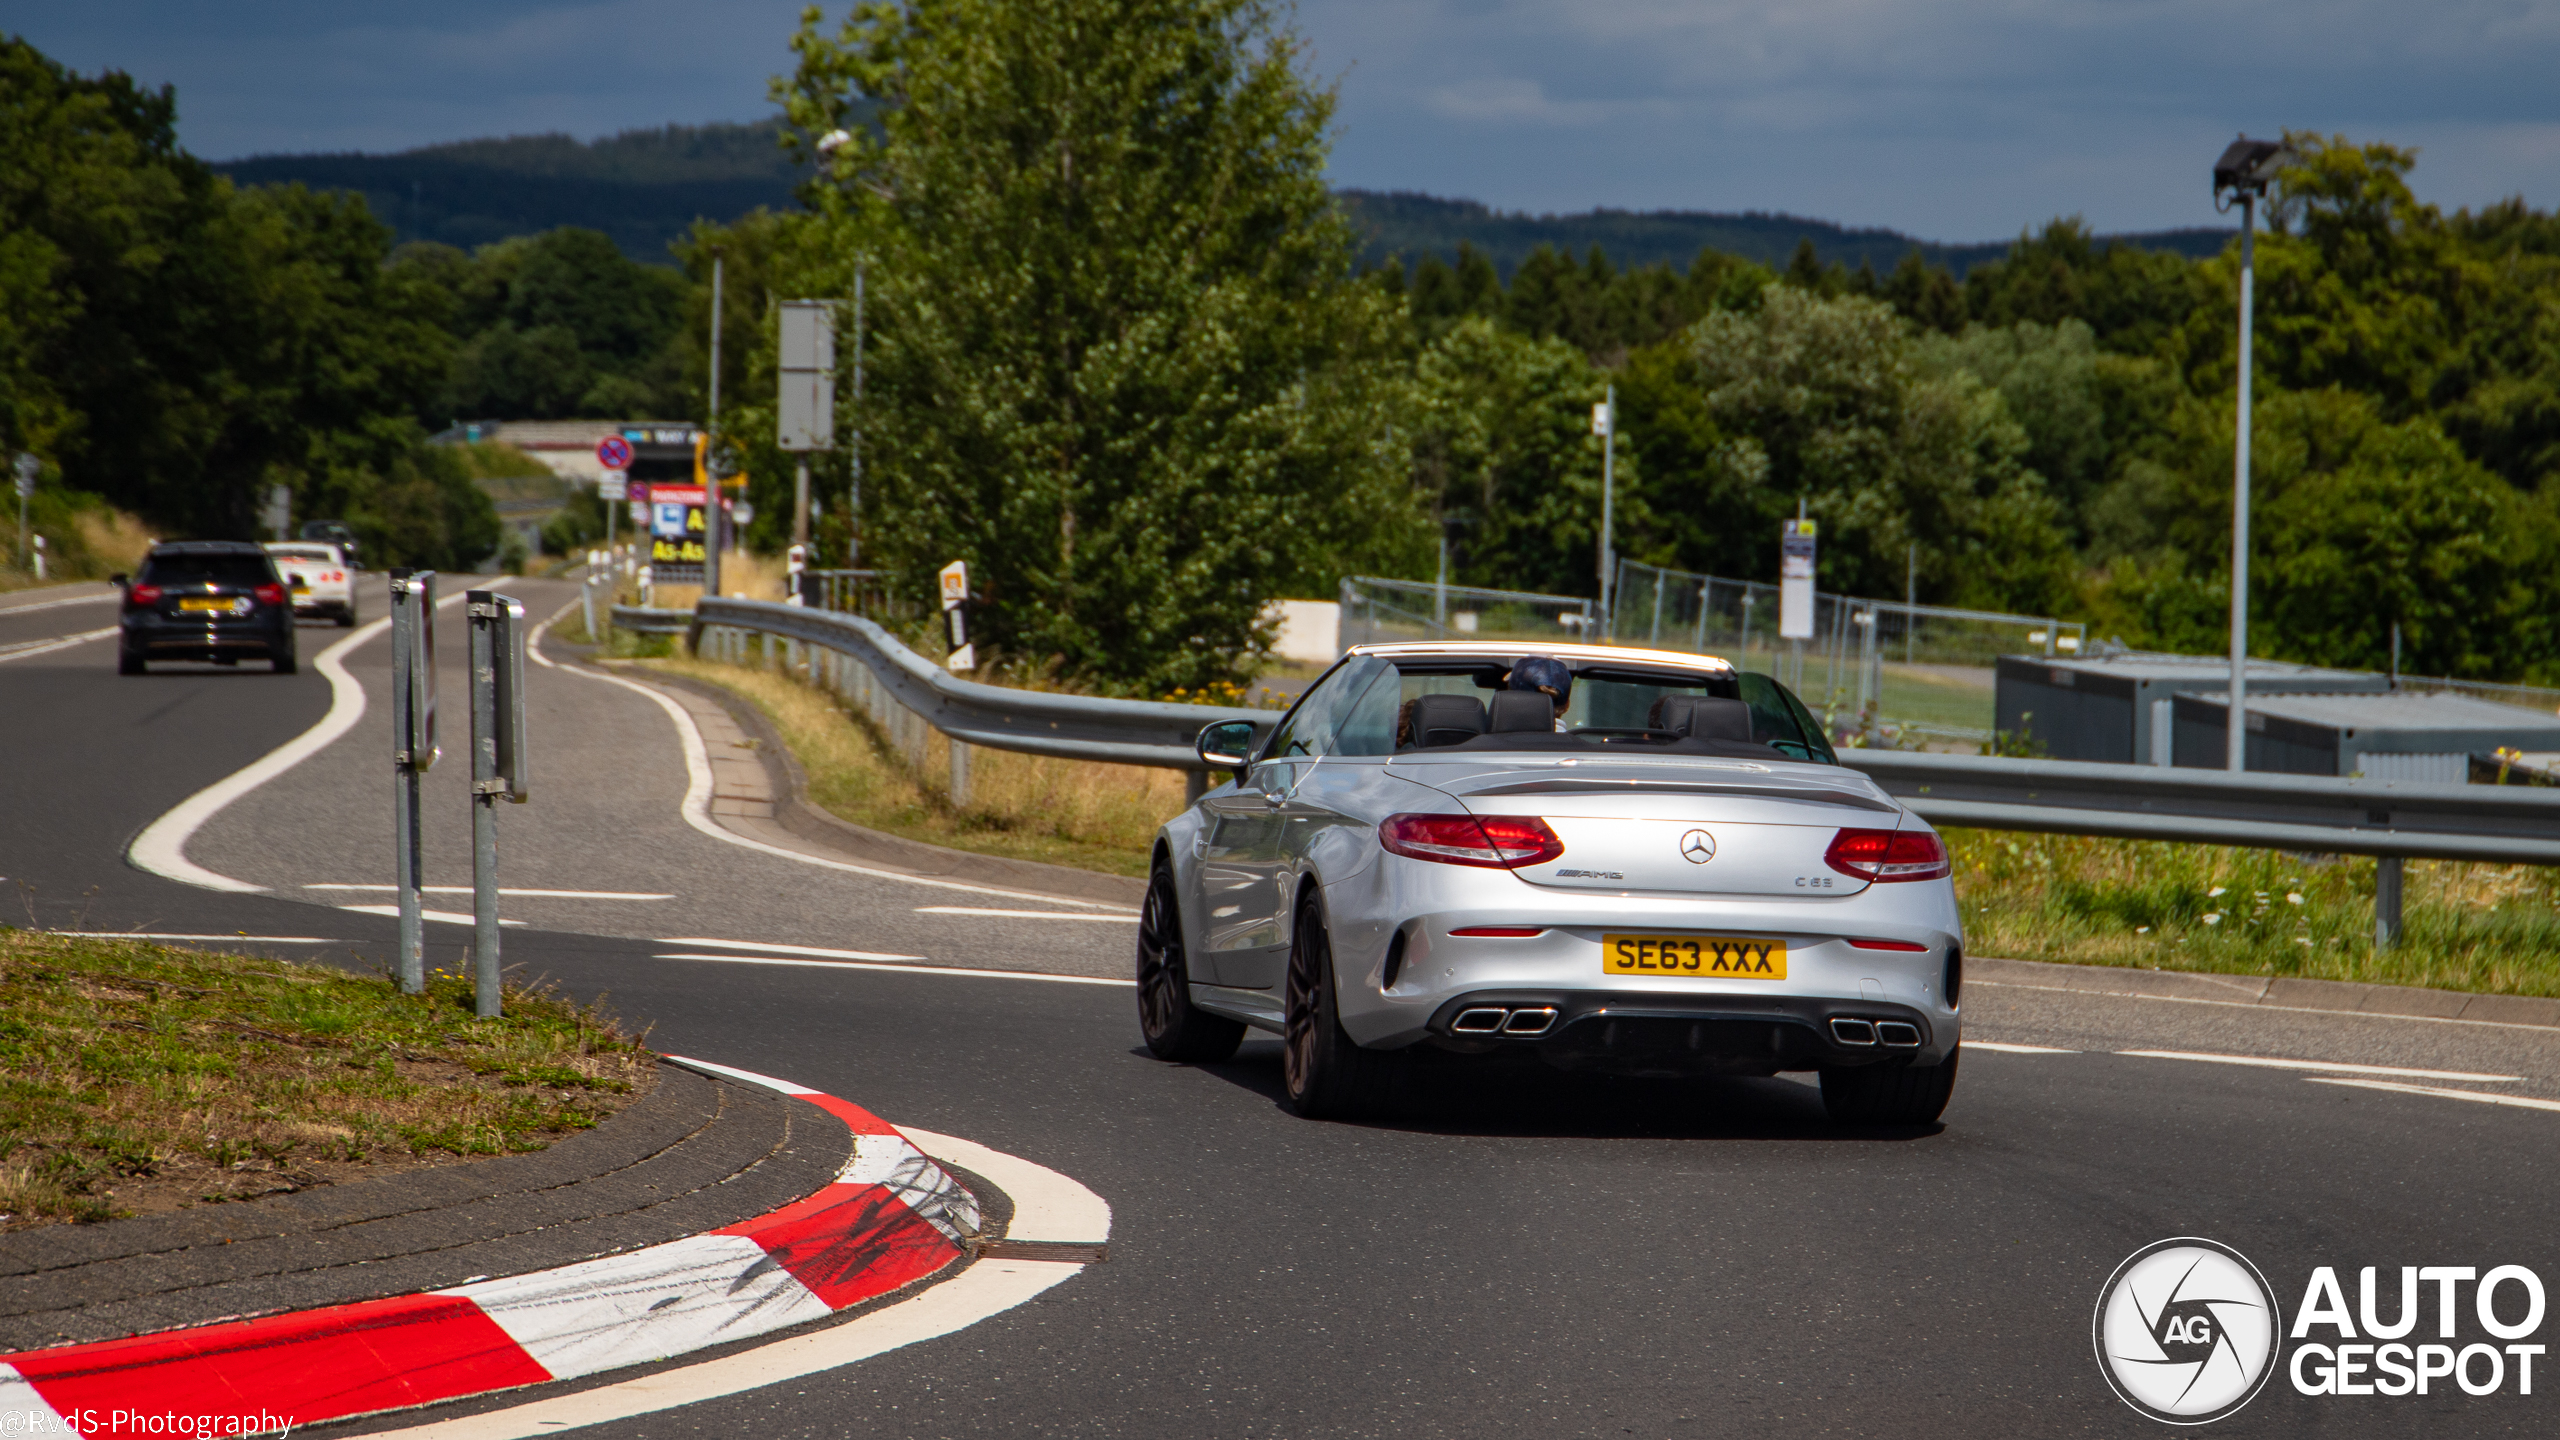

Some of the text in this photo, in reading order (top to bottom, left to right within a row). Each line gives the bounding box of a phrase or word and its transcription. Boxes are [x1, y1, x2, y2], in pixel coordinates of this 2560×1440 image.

[1579, 870, 1624, 880] AMG
[1795, 876, 1833, 888] C 63
[1616, 939, 1773, 973] SE63 XXX
